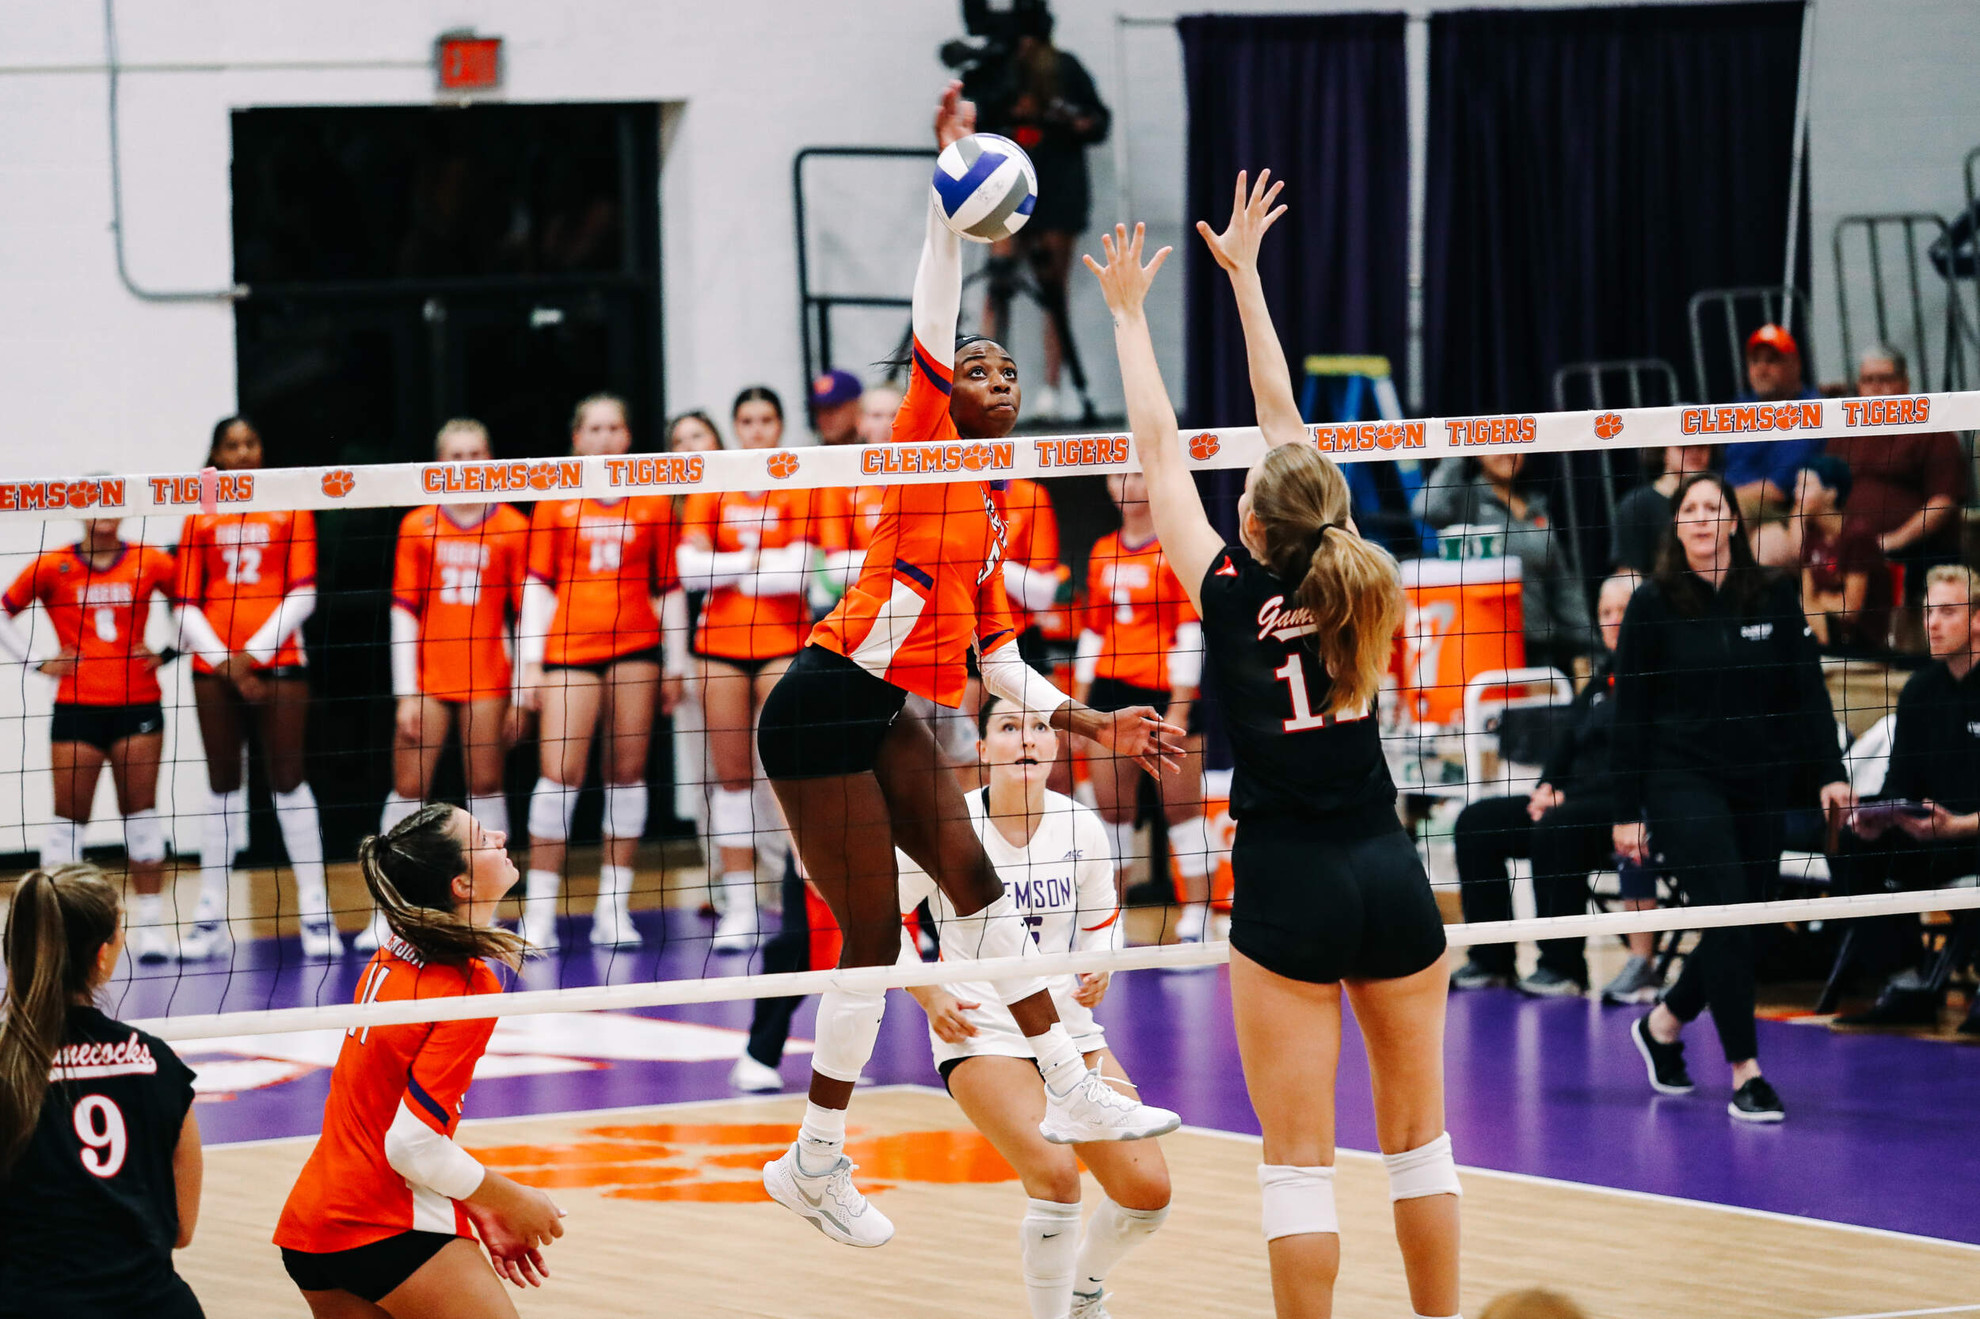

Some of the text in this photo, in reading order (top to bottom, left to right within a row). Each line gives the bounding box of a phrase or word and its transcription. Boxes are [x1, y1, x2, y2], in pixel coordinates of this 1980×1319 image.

[1842, 397, 1930, 427] TIGERS
[1306, 416, 1537, 453] EMSON TIGERS
[1034, 436, 1129, 467] TIGERS
[605, 455, 704, 486] TIGERS
[149, 475, 254, 505] TIGRS
[72, 1094, 129, 1178] 9
